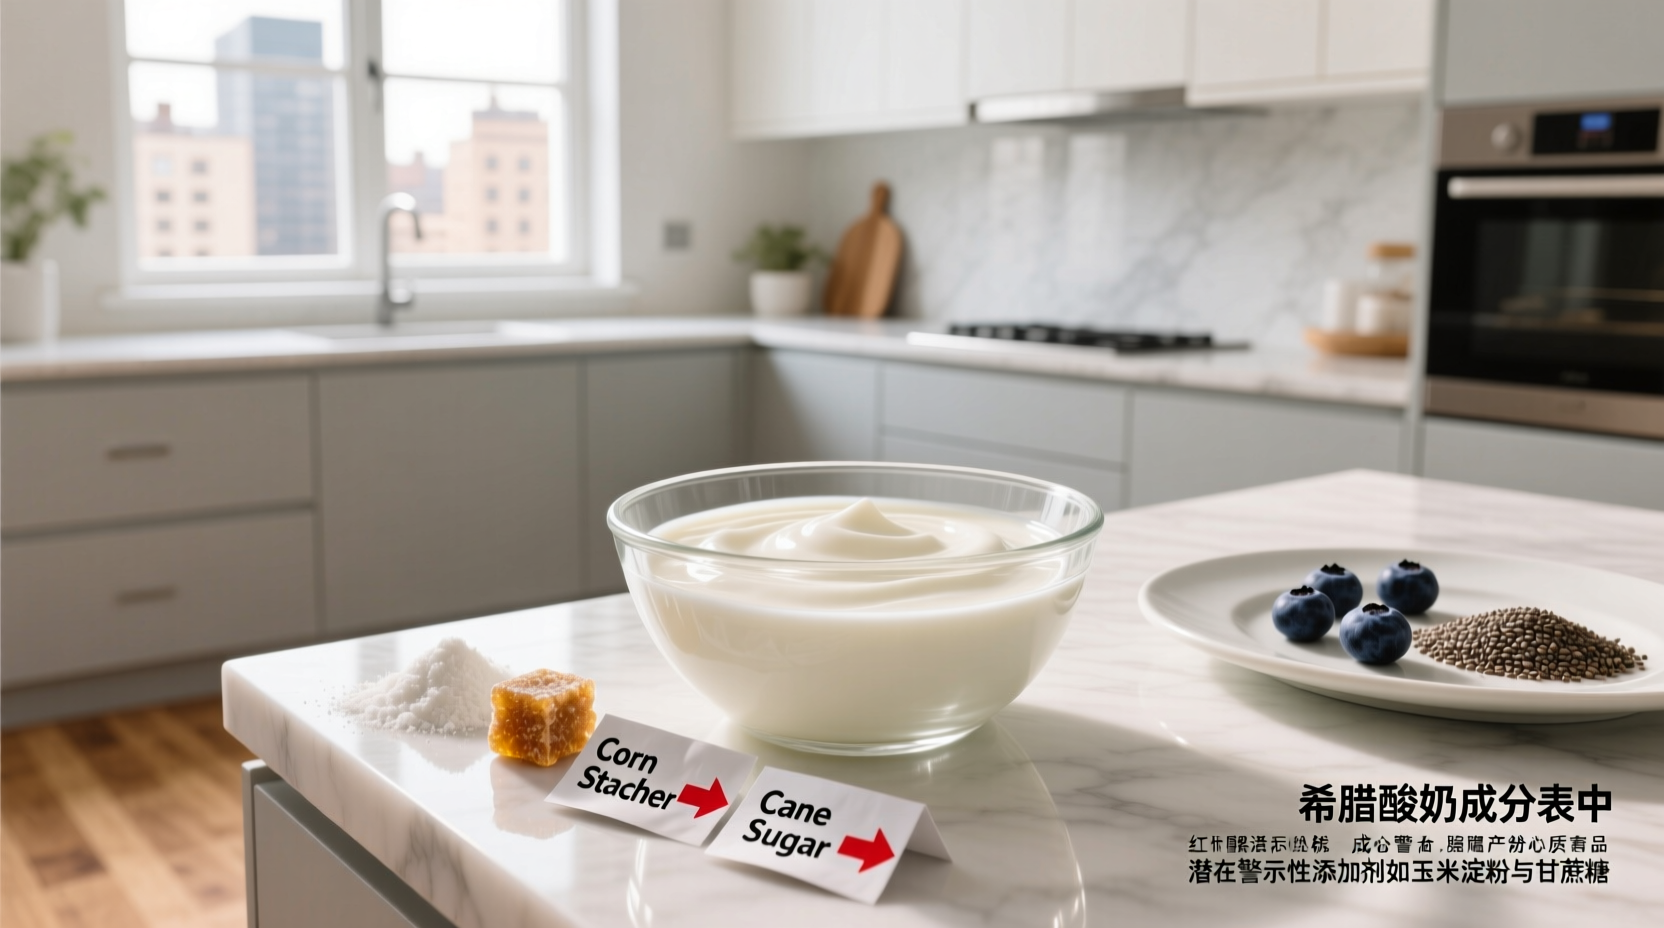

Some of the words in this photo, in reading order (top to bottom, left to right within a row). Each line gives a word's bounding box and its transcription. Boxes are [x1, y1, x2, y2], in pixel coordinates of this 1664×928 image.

[596, 737, 658, 775] Corn
[576, 765, 677, 811] Stacher
[760, 789, 832, 826] Cane
[742, 818, 832, 859] Sugar
